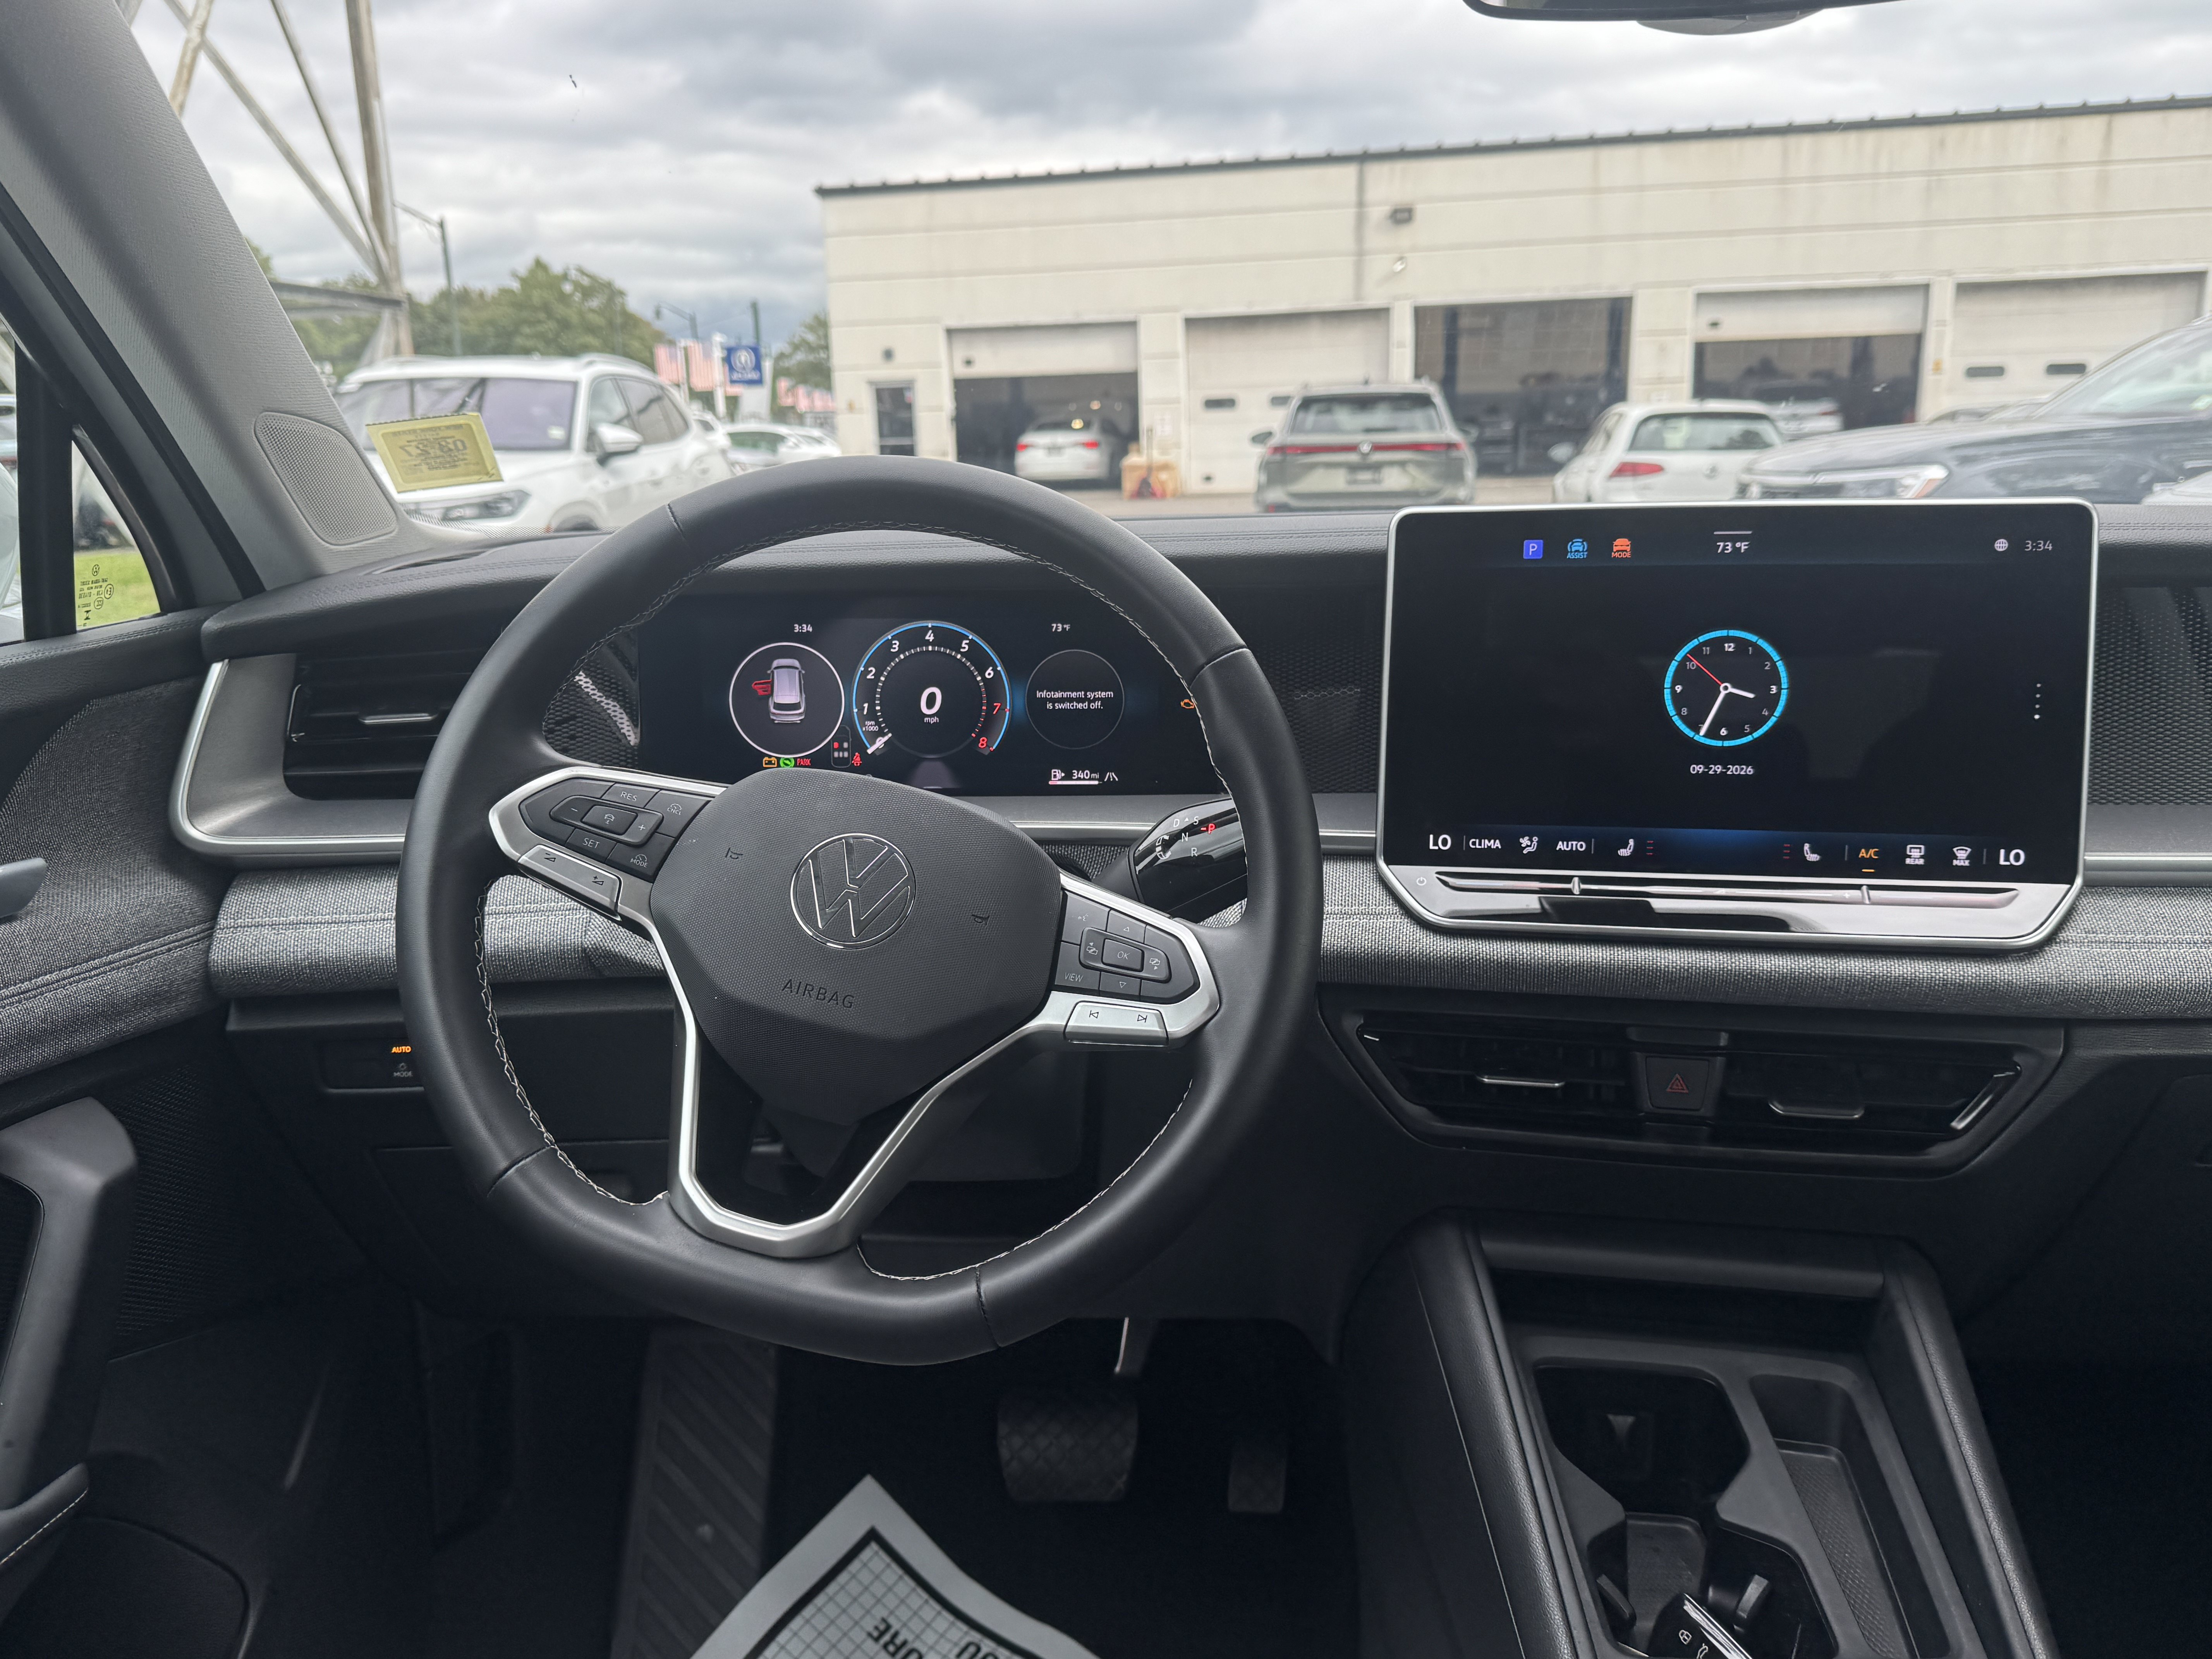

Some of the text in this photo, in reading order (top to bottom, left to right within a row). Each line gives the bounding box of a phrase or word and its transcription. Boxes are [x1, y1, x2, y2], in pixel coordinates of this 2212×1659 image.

[1529, 544, 1537, 555] P
[2025, 540, 2052, 551] 3:34
[794, 624, 812, 633] 3:34
[925, 630, 934, 642] 4
[891, 641, 899, 652] 3
[960, 640, 969, 652] 5
[1724, 643, 1735, 651] 12
[867, 667, 876, 679] 2
[985, 667, 994, 678] 6
[1675, 685, 1683, 693] 9
[1770, 685, 1777, 694] 3
[1036, 690, 1113, 700] Infotainment system
[920, 687, 942, 715] 0
[1090, 701, 1103, 709] off.
[863, 703, 869, 715] 1
[993, 703, 1001, 714] 7
[1720, 727, 1728, 735] 6
[978, 737, 988, 748] 8
[1690, 764, 1755, 775] 09-29-2026
[621, 791, 637, 802] RES
[667, 806, 682, 815] CNCL
[1173, 816, 1199, 828] D S
[1207, 823, 1216, 834] P
[583, 838, 600, 848] SET
[1182, 833, 1188, 842] N
[1429, 835, 1451, 850] LO
[1469, 838, 1501, 849] CLIMA
[1556, 841, 1586, 852] AUTO
[1191, 847, 1197, 857] R
[1858, 848, 1879, 859] A/C
[1999, 849, 2025, 866] LO
[630, 857, 648, 868] MODE
[1117, 951, 1130, 960] OK
[1065, 972, 1083, 982] VIEW
[781, 978, 855, 1008] AIRBAG
